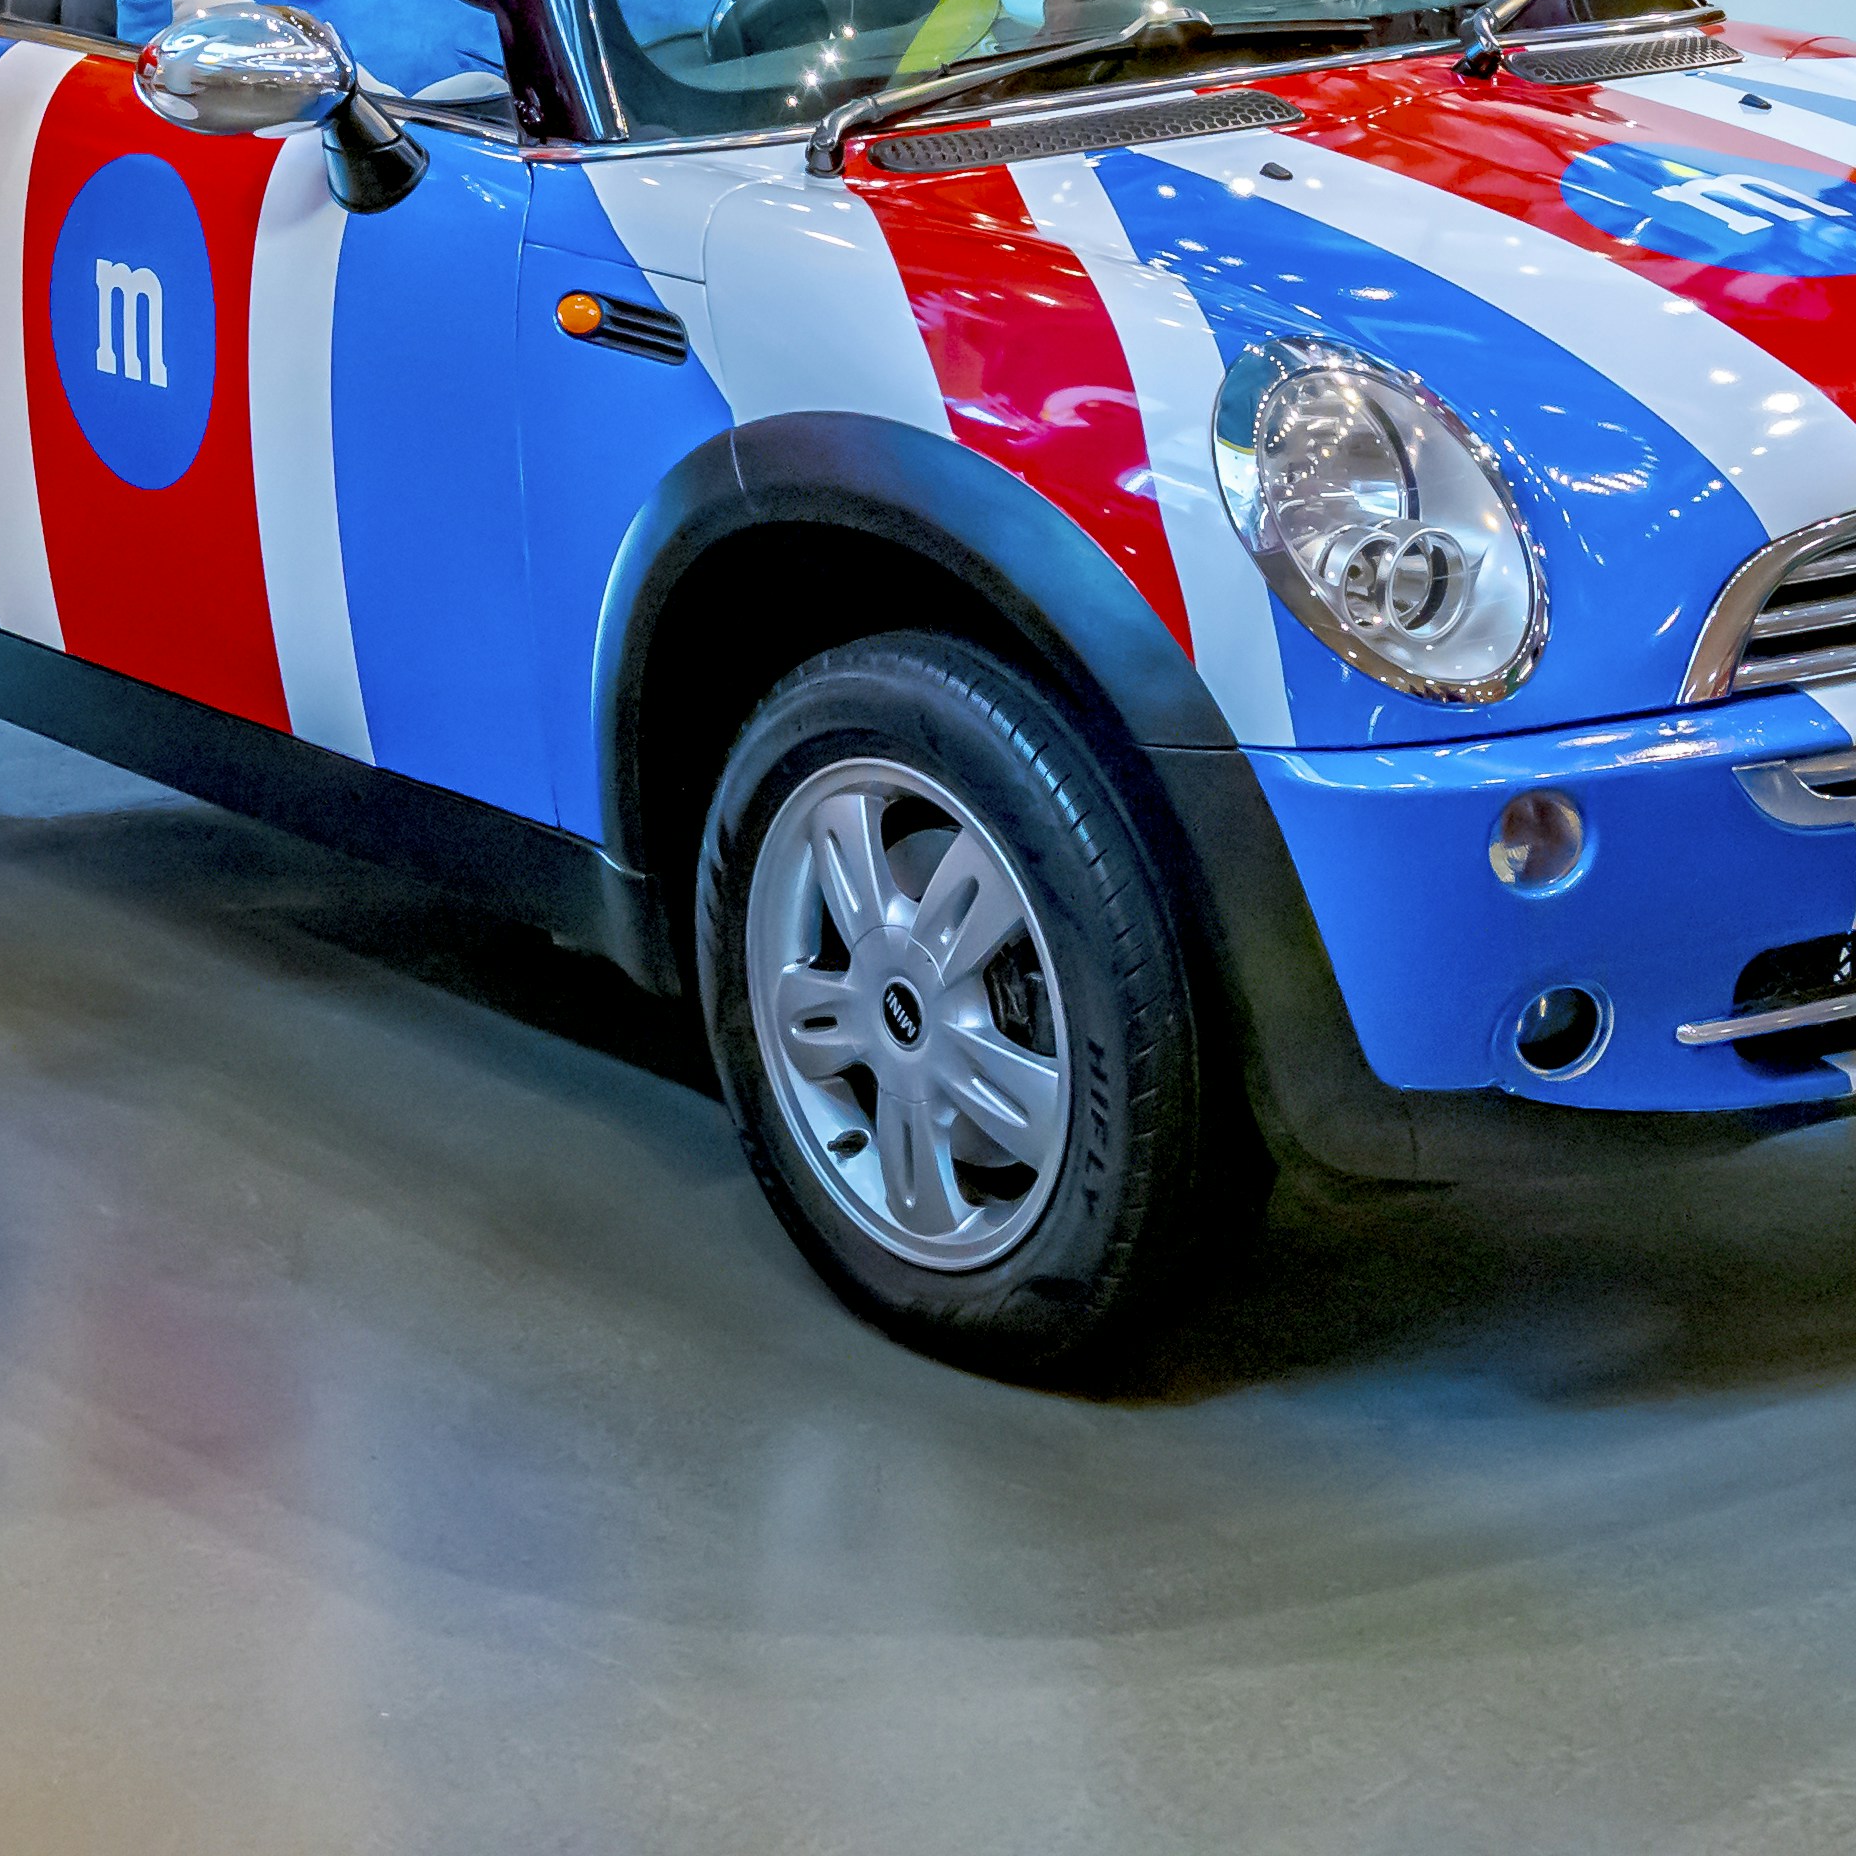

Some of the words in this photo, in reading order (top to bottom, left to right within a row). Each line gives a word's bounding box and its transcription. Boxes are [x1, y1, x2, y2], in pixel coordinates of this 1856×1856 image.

[1652, 174, 1853, 235] m
[96, 258, 168, 388] m
[886, 991, 917, 1038] MINI
[1081, 1036, 1111, 1216] HIFLY
